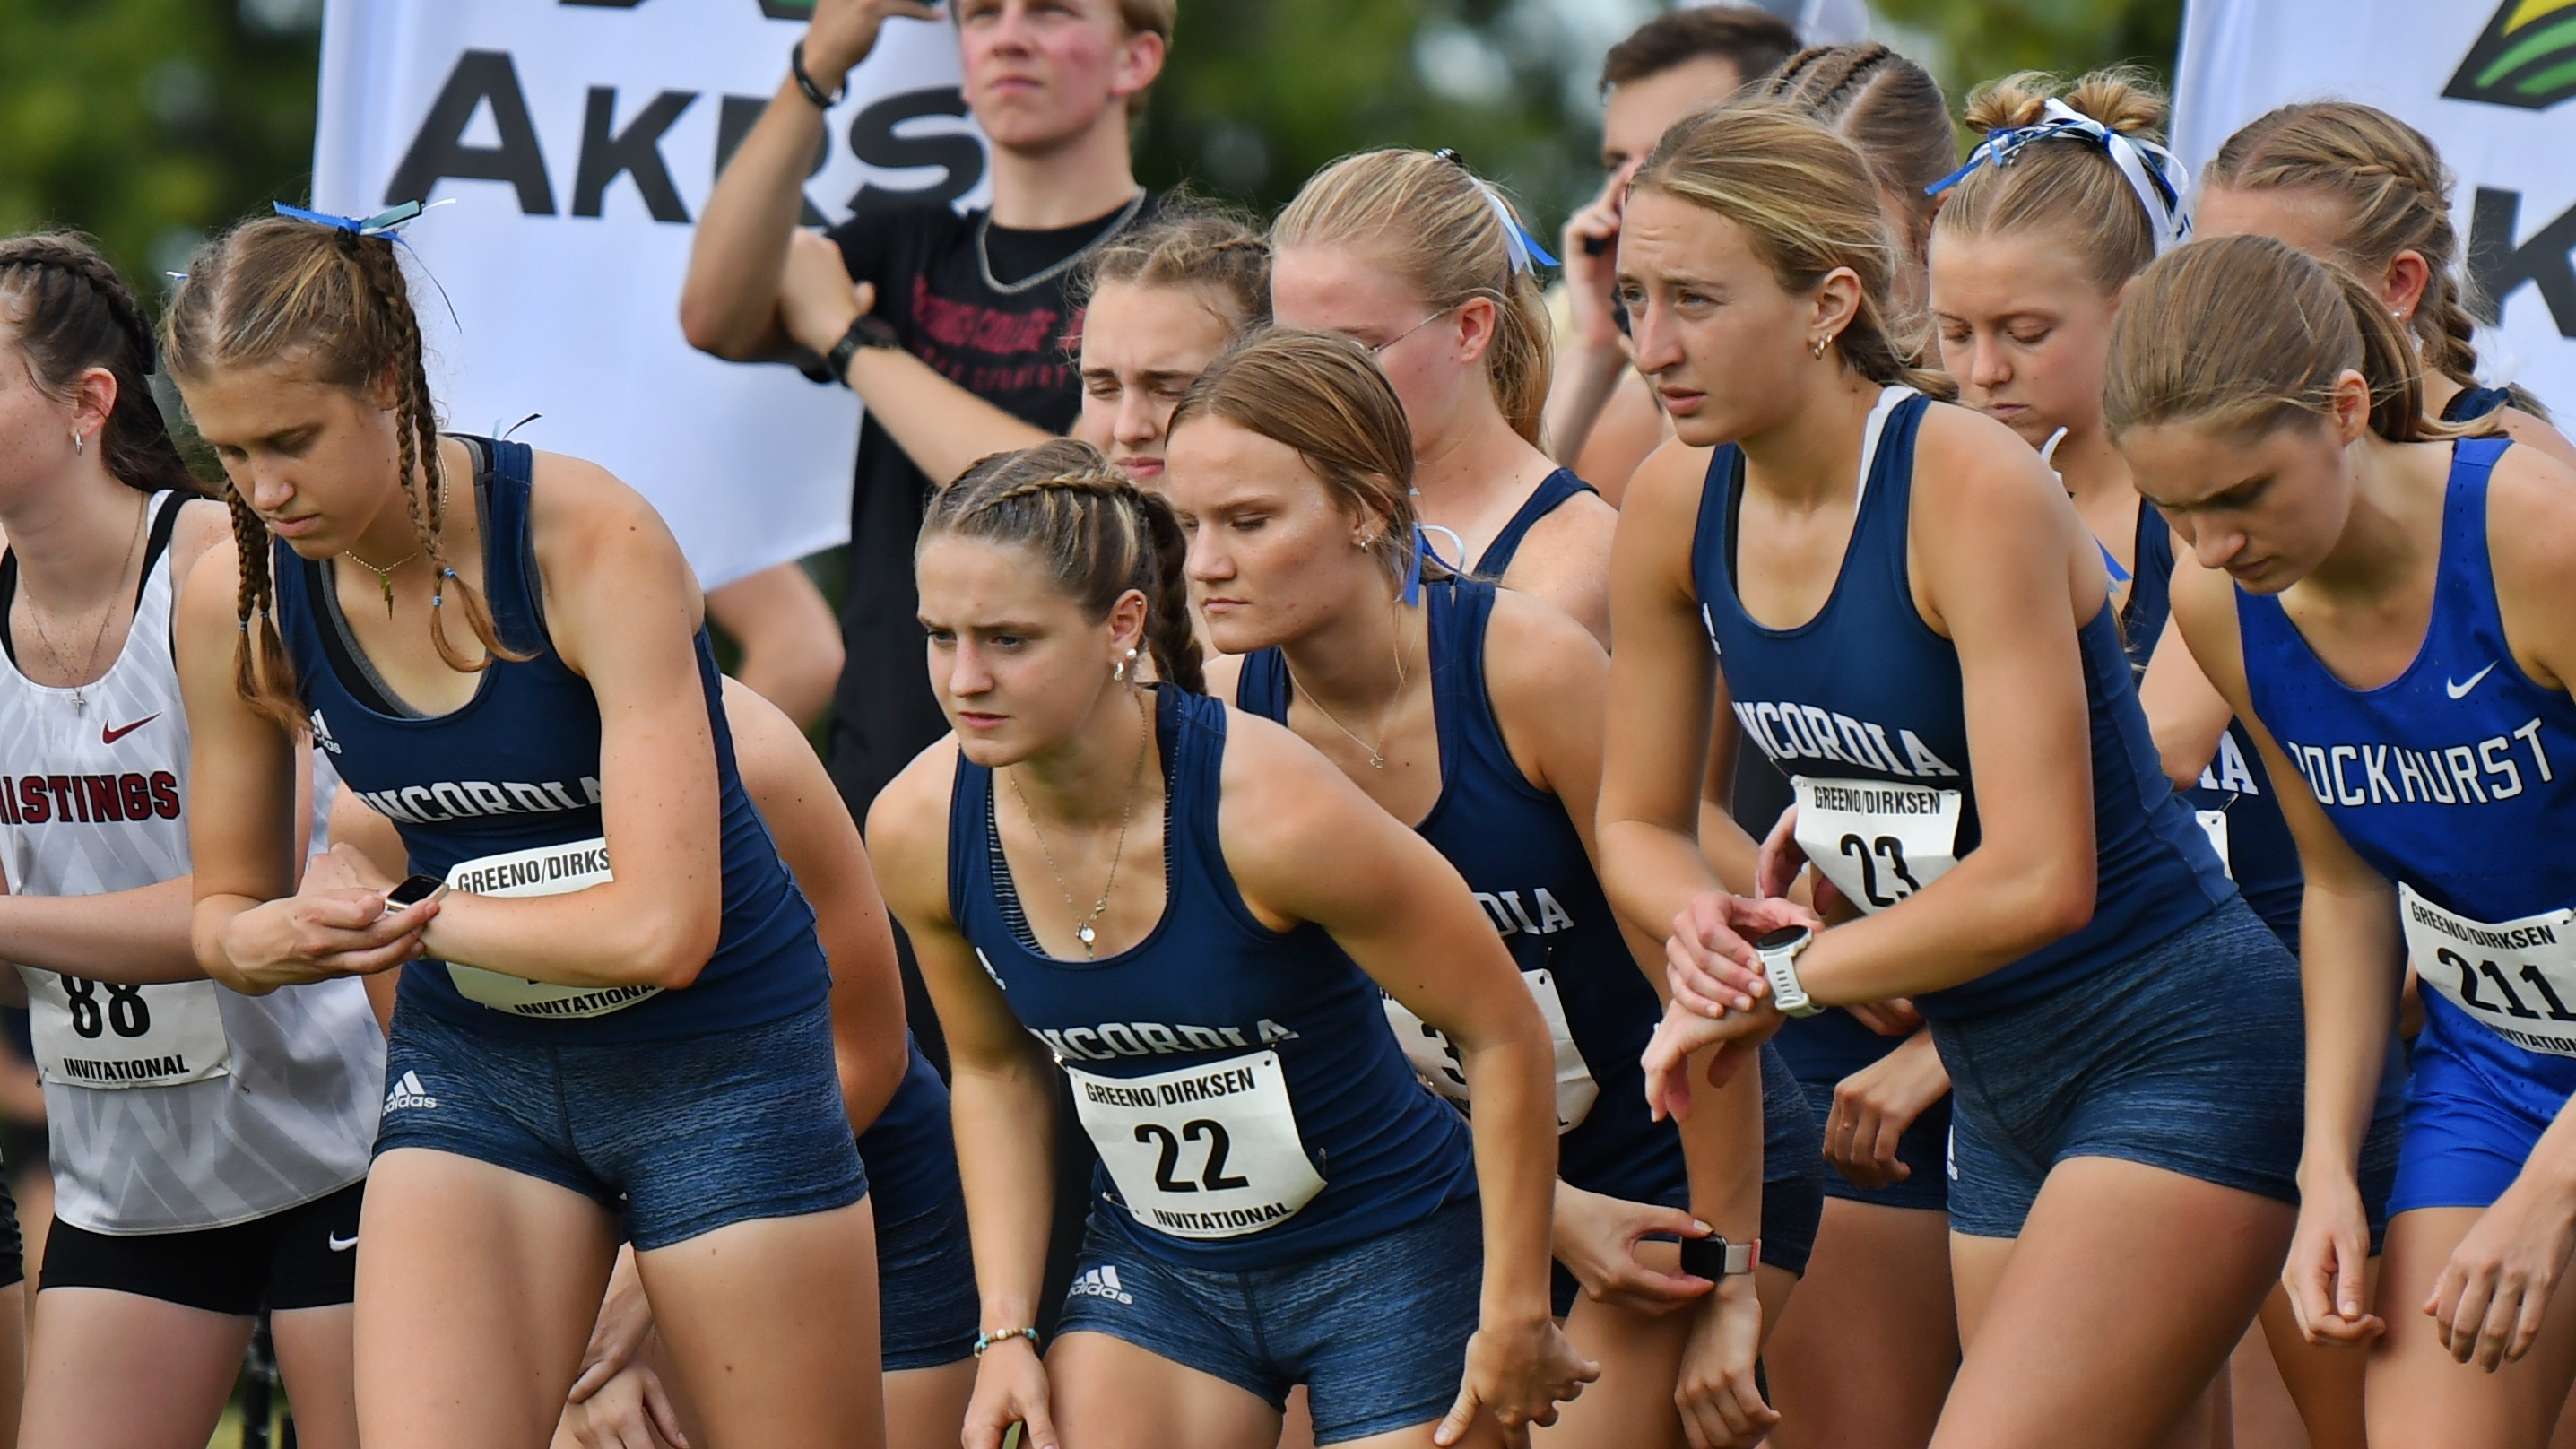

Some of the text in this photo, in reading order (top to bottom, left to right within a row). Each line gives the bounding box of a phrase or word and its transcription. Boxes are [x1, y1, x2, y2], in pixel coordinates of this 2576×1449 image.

[1814, 785, 1941, 815] GREENO/DIRKSEN
[1840, 833, 1921, 907] 23
[2410, 900, 2557, 950] GREENO/DIRKSEN
[60, 974, 151, 1038] 88
[63, 1054, 190, 1080] INVITATIONAL
[1085, 1067, 1256, 1109] GREENO/DIRKSEN
[1133, 1119, 1250, 1193] 22
[1152, 1202, 1294, 1230] INVITATIONAL
